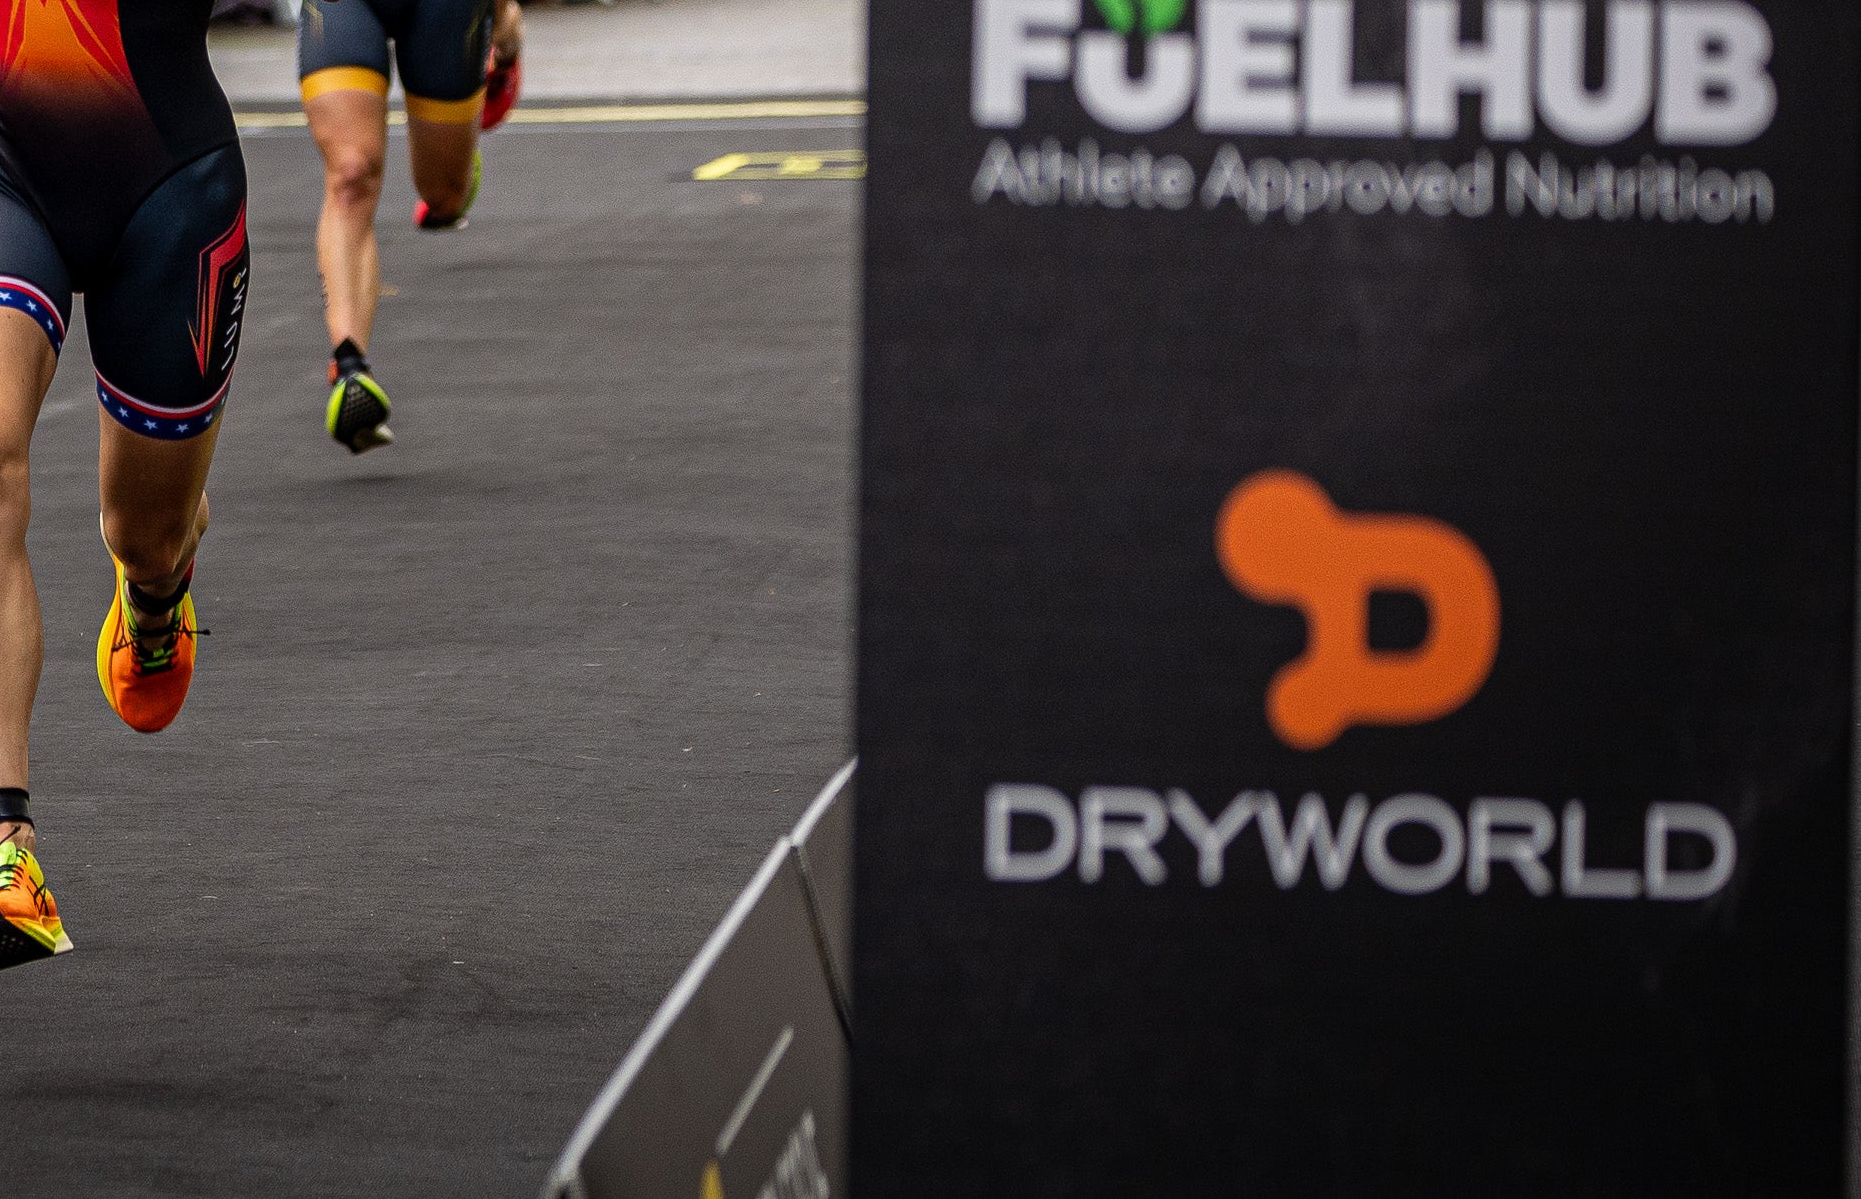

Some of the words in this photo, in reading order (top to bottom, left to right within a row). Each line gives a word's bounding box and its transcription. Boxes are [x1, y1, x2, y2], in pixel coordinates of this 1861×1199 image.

[971, 138, 1195, 211] Athlete
[1201, 143, 1495, 223] Approved
[1505, 151, 1775, 224] Nutrition
[983, 783, 1737, 900] DRYWORLD
